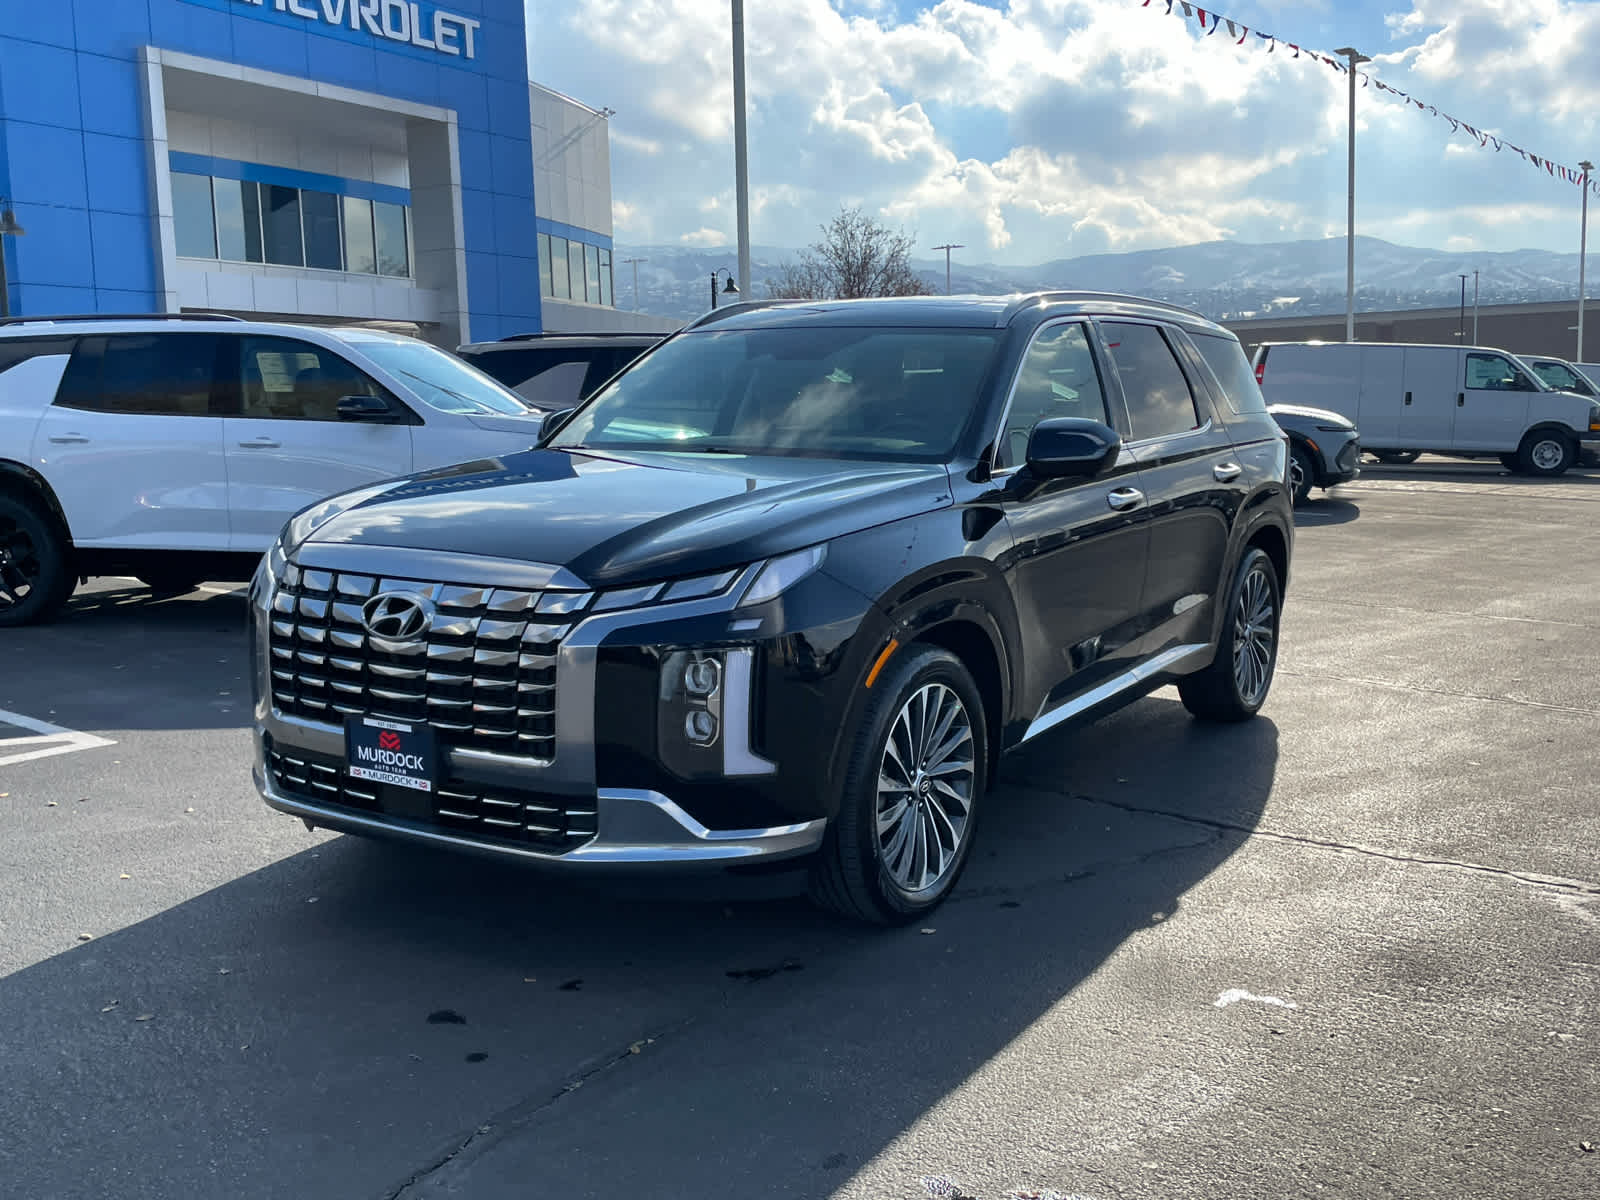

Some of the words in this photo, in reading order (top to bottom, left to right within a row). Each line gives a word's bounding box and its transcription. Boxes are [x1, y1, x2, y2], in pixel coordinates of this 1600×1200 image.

[358, 745, 424, 771] MURDOCK
[374, 764, 390, 772] AUTO
[368, 770, 412, 786] MURDOCK
